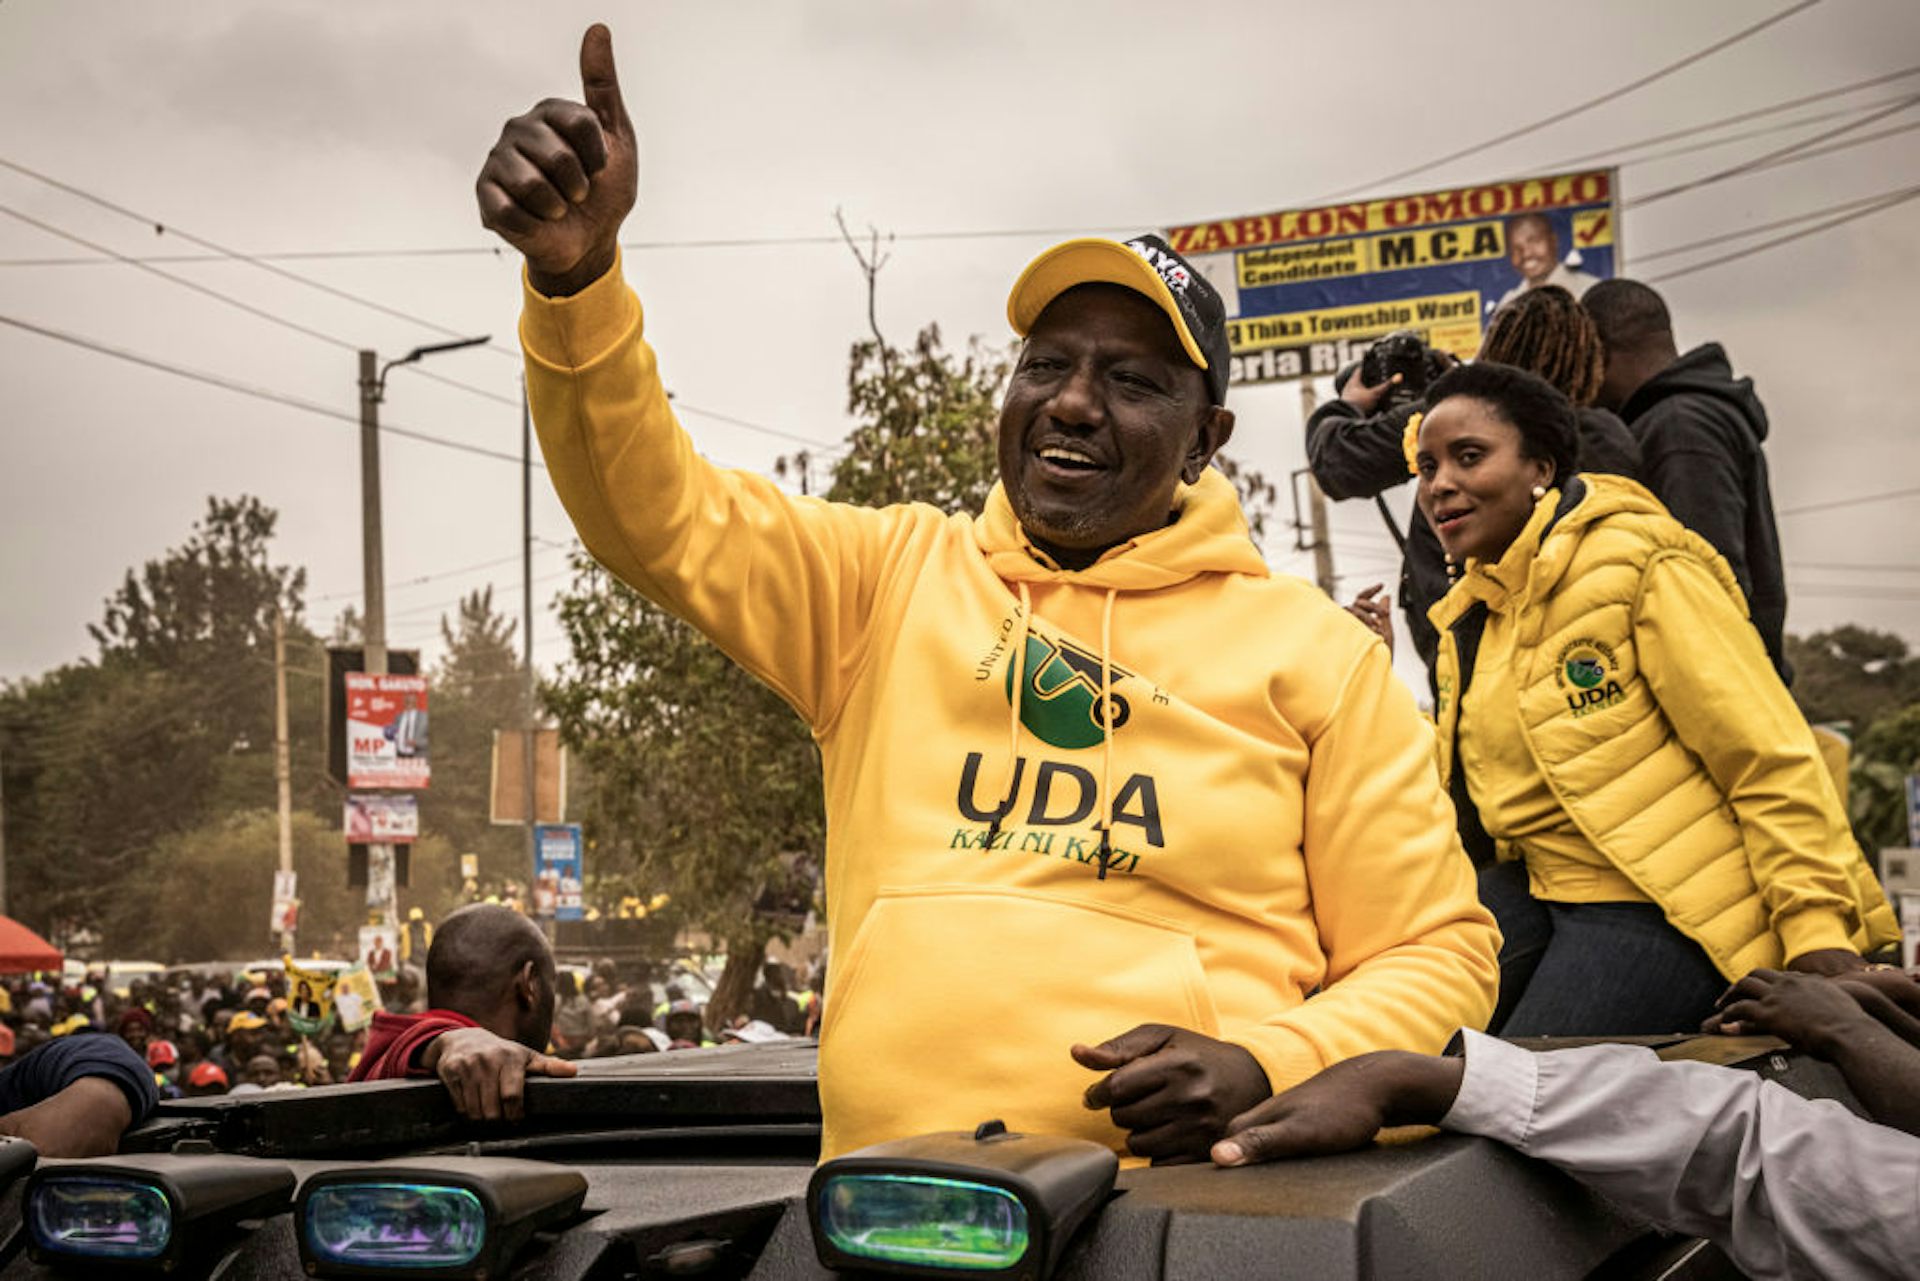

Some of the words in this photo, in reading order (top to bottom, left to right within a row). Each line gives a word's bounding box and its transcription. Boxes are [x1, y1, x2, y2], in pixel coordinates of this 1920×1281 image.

[1169, 203, 1368, 252] ZABLON
[1383, 173, 1608, 227] OMOLLO
[1243, 240, 1354, 266] Independent
[1379, 224, 1500, 267] M.C.A
[1244, 261, 1356, 285] Candidate
[1245, 320, 1303, 341] Thika
[1308, 303, 1411, 333] Township
[1417, 297, 1475, 320] Ward
[1567, 681, 1624, 710] UDA
[957, 752, 1165, 848] UDA
[1021, 831, 1055, 855] NI
